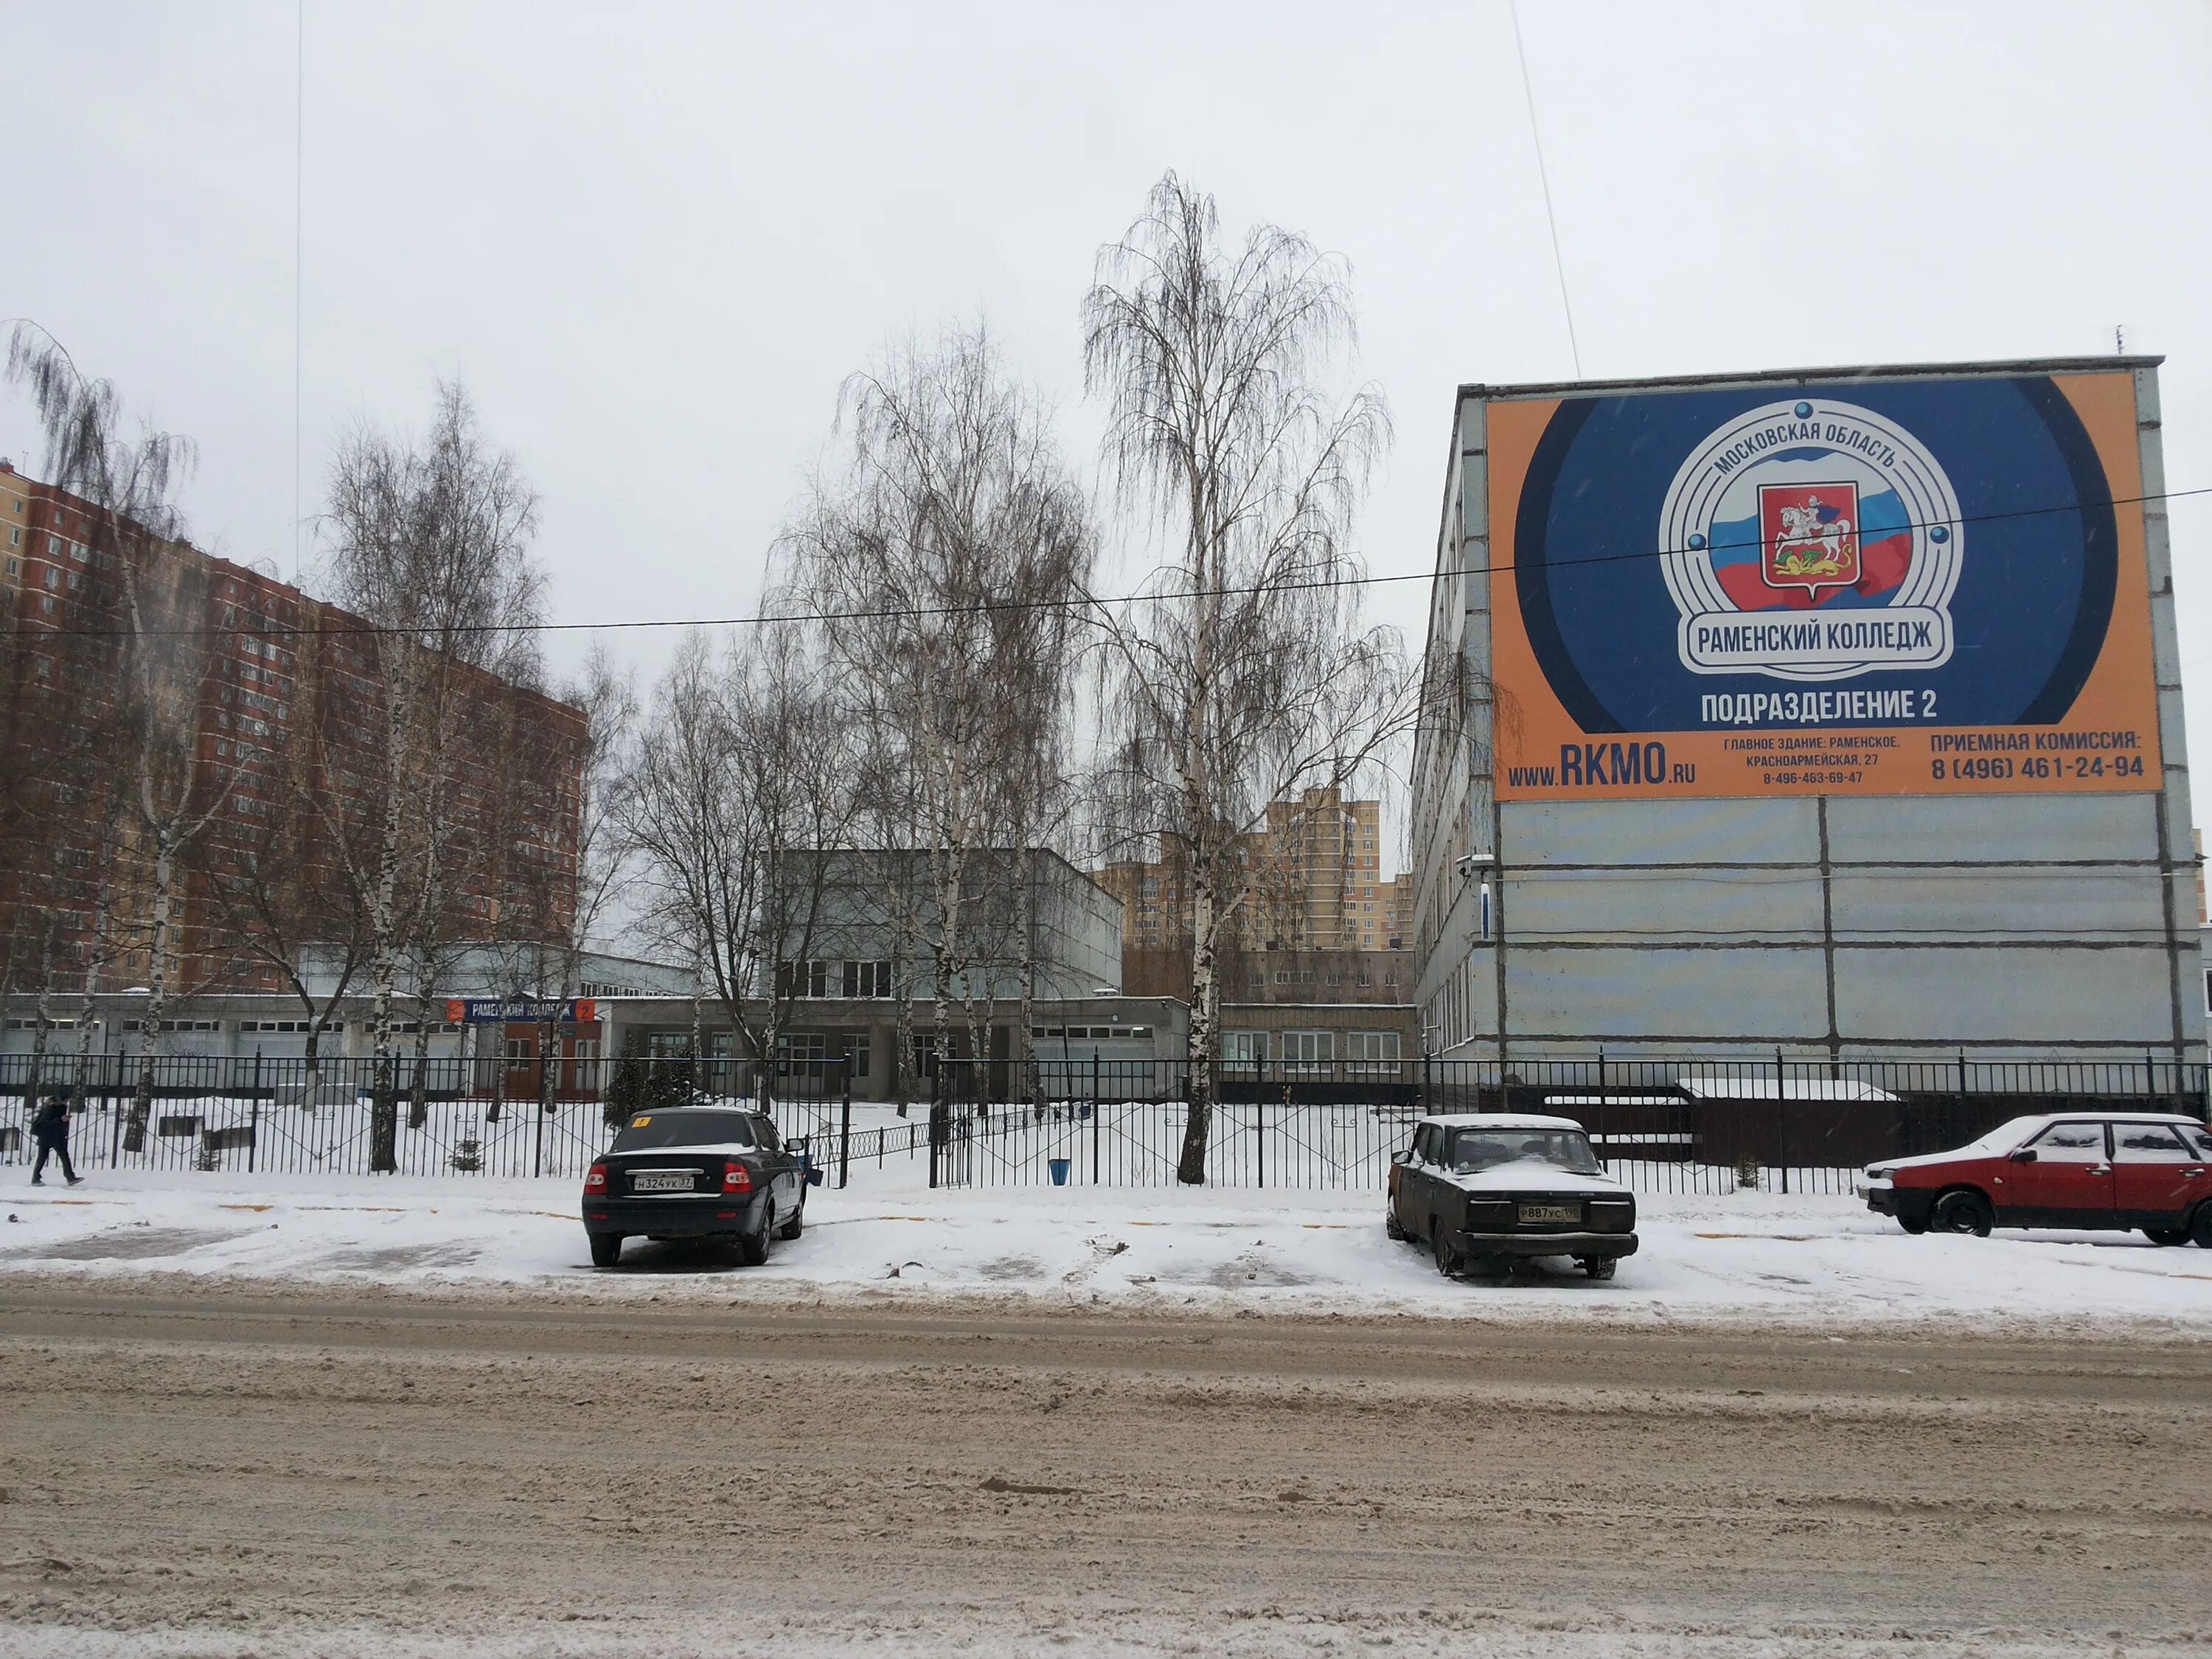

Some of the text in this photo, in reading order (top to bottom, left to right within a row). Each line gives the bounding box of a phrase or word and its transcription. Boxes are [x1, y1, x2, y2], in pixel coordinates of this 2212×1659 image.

[1714, 422, 1896, 475] МОСКОВСКАЯ ОБЛАСТЬ
[1698, 618, 1933, 653] РАМЕНСКИЙ КОЛЛЕДЖ
[1702, 689, 1938, 725] ПОДРАЗДЕЛЕНИЕ 2
[1724, 736, 1900, 750] ГЛАВНОЕ ЗДАНИЕ: РАМЕНСКОЕ,
[1930, 731, 2141, 752] ПРИЕМНАЯ КОМИССИЯ:
[1746, 752, 1879, 767] КРАСНОАРМЕЙСКАЯ, 27
[1932, 755, 2144, 779] 8 (496) 461-24-94
[1764, 771, 1863, 785] 8-496-463-69-47
